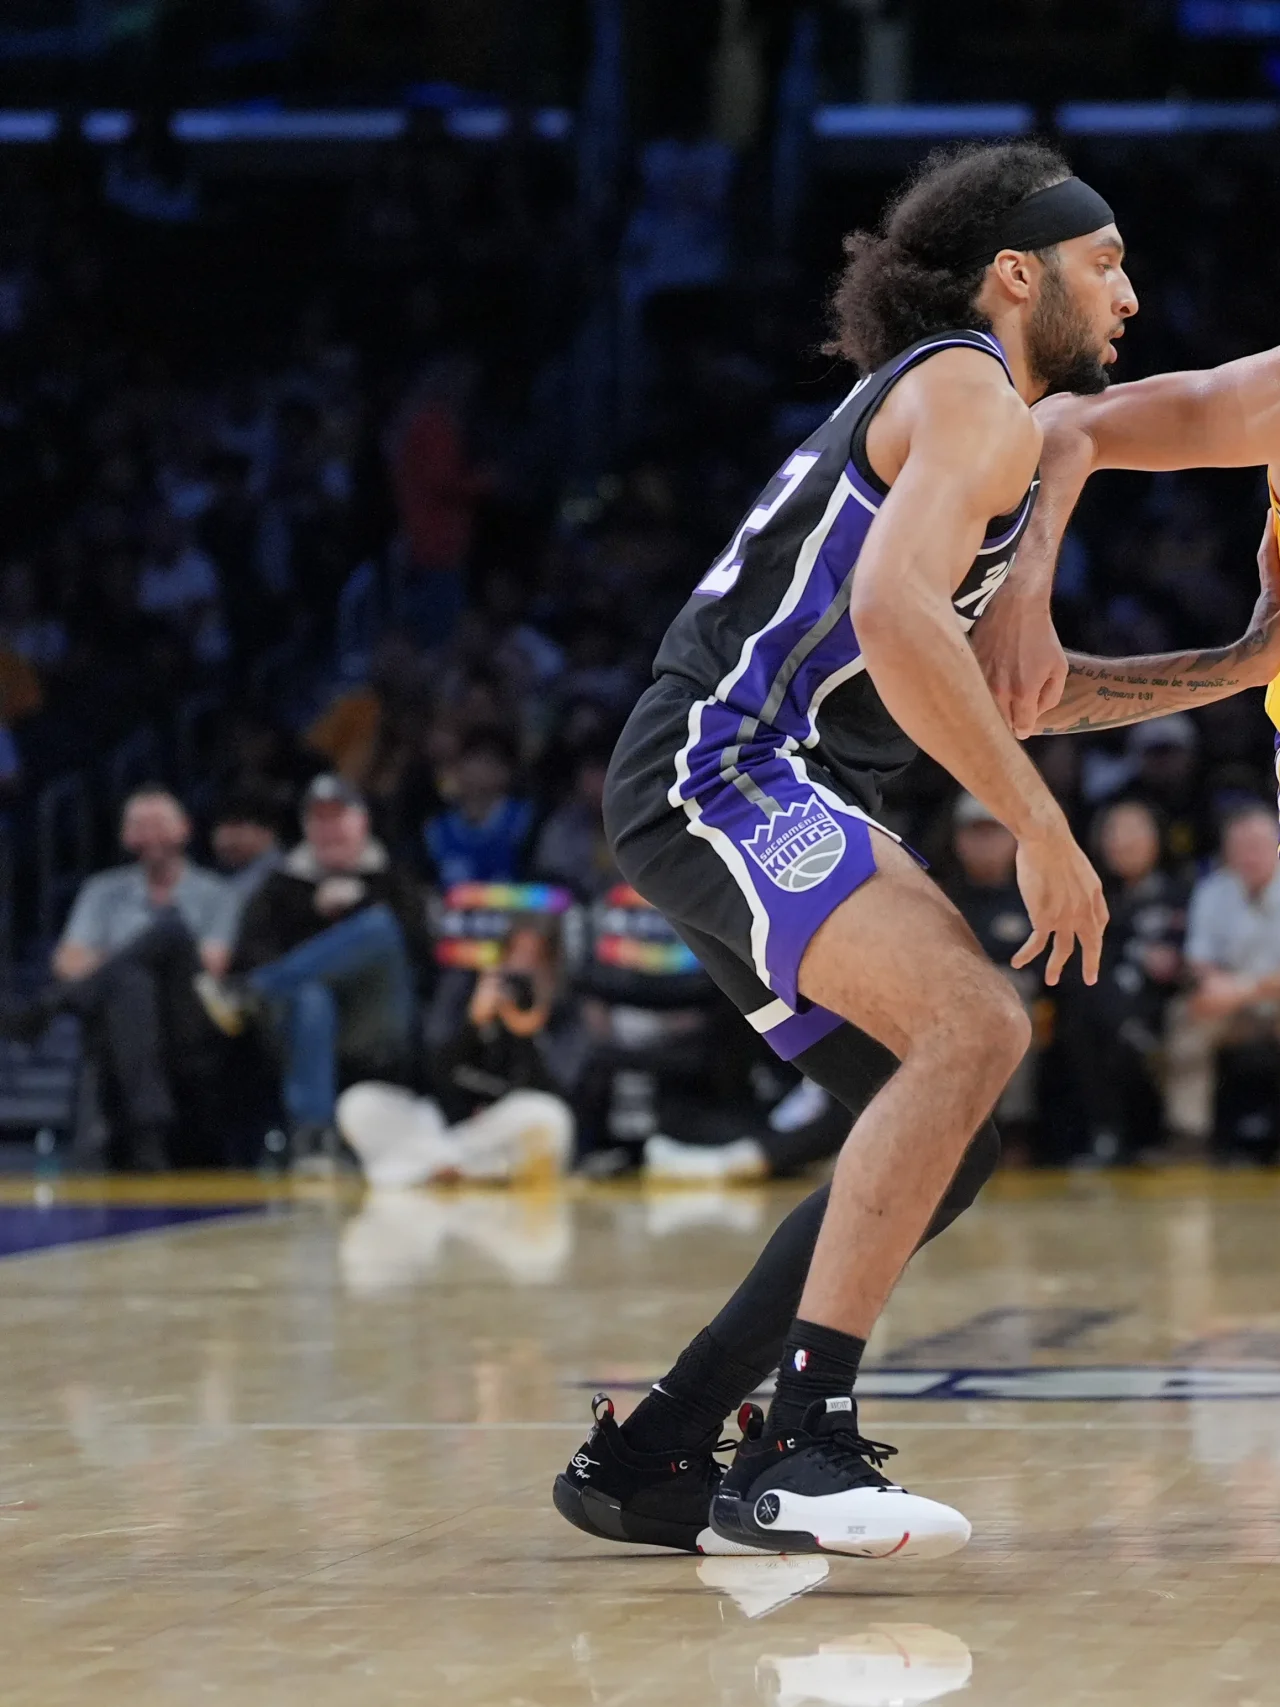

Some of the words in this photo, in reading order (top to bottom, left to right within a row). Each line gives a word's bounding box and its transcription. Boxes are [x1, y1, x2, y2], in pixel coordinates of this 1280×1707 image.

[1086, 669, 1094, 677] is
[1092, 669, 1112, 681] for
[1113, 675, 1126, 683] us
[1127, 674, 1148, 685] who
[1151, 678, 1169, 687] can
[1171, 674, 1183, 687] be
[1186, 677, 1226, 692] against
[1097, 686, 1135, 701] Romans
[759, 812, 826, 862] SACRAMENTO
[764, 819, 840, 881] KINGS
